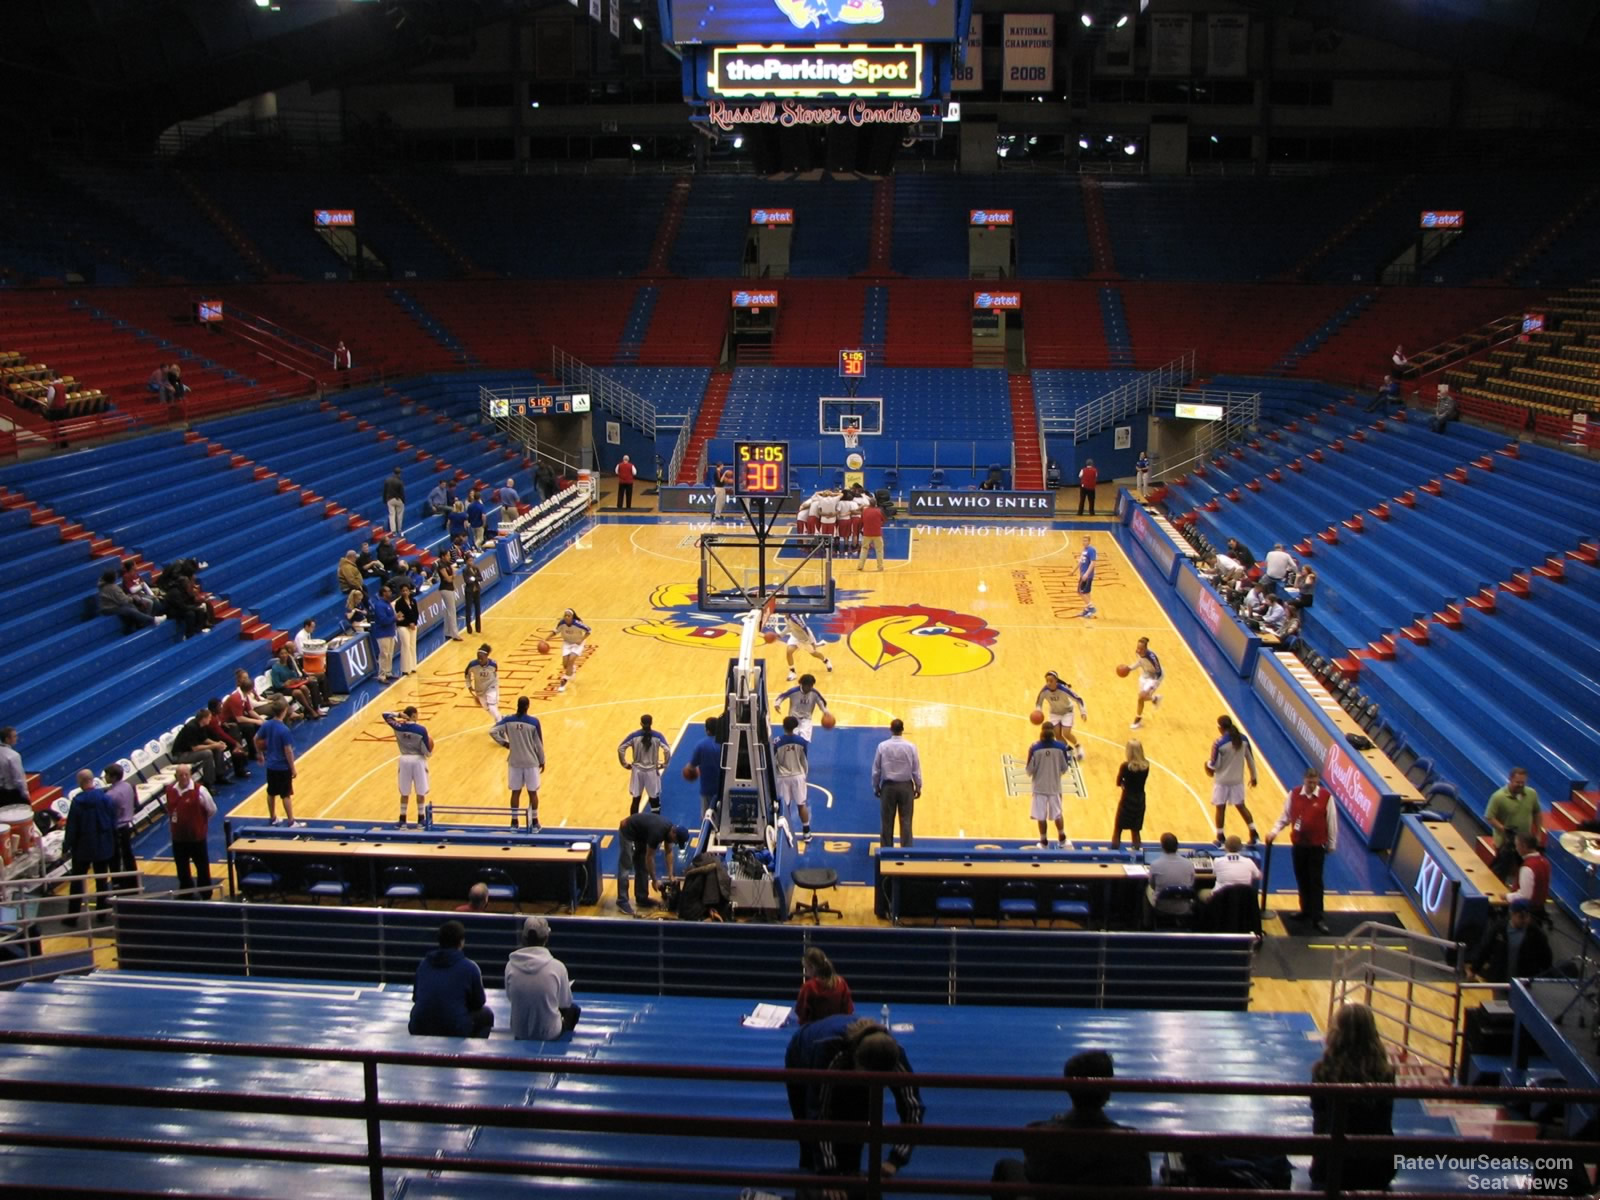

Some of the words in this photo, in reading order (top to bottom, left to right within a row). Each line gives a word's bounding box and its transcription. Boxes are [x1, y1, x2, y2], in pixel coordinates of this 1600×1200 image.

[1009, 27, 1048, 36] NATIONAL
[1005, 39, 1052, 49] CHAMPIONS
[726, 59, 908, 84] theParkingSpot
[1010, 66, 1046, 81] 2008
[706, 99, 778, 130] Russell
[779, 98, 846, 127] Stover
[848, 98, 921, 127] Candies
[751, 292, 775, 305] at&t
[993, 295, 1017, 306] at&t
[845, 360, 861, 374] 30
[740, 446, 783, 462] 51:05
[747, 463, 778, 491] 30
[915, 495, 944, 508] ALL
[947, 495, 990, 508] WHO
[996, 496, 1048, 509] ENTER
[507, 537, 520, 564] KU
[428, 604, 440, 618] TO
[347, 635, 369, 679] KU
[1327, 742, 1353, 788] Russell
[1349, 768, 1372, 817] Stover
[1413, 849, 1449, 914] KU
